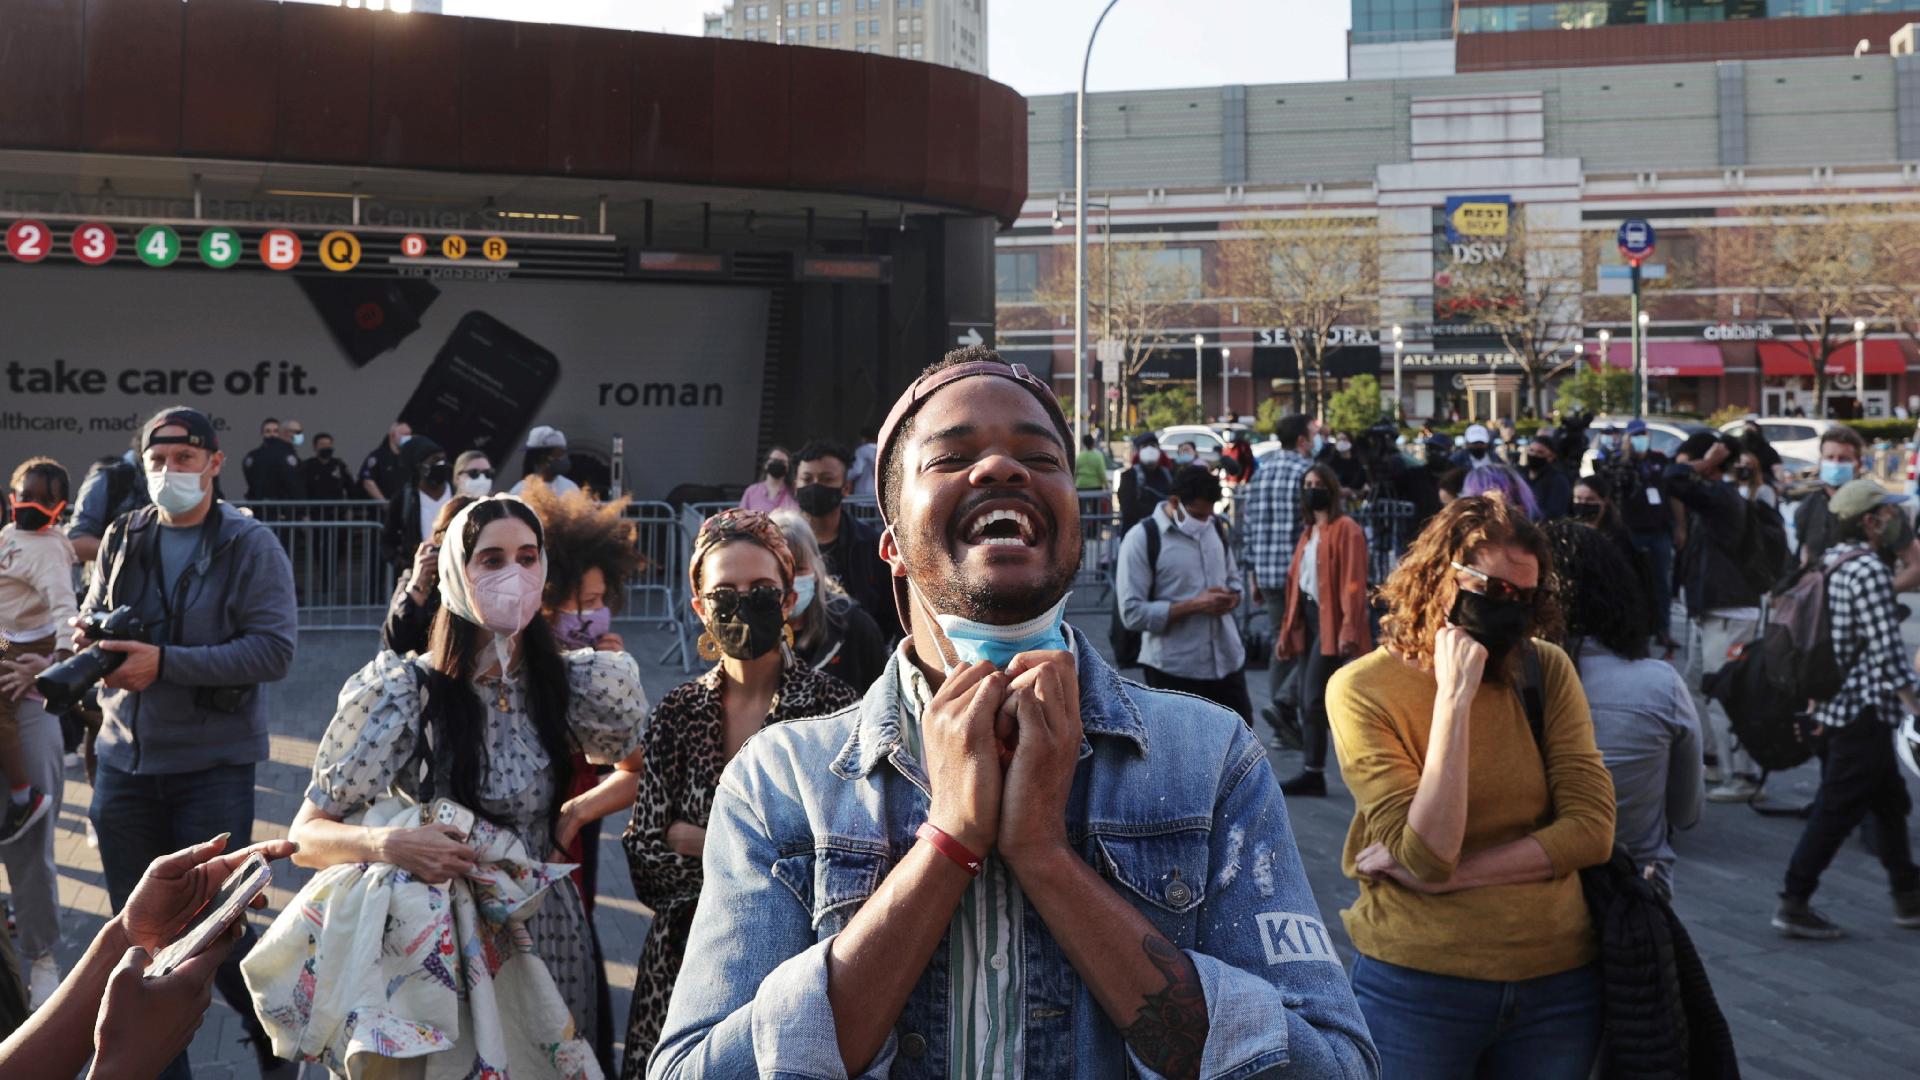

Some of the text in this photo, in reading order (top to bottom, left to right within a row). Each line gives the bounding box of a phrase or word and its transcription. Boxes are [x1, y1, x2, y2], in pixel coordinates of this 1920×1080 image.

[53, 191, 186, 218] Avenue
[206, 199, 350, 225] Barclays
[364, 202, 472, 230] Center
[479, 207, 590, 234] Station
[1463, 208, 1503, 218] BEST
[17, 225, 502, 264] 2 3 4 5 B Q D N R
[1452, 243, 1508, 265] DSW
[398, 266, 510, 283] via passage
[1403, 353, 1563, 366] ATLANTIC TERAL
[6, 360, 318, 396] take care of it.
[599, 381, 724, 407] roman
[0, 411, 139, 434] lthcare, mad
[1266, 919, 1329, 956] KIT
